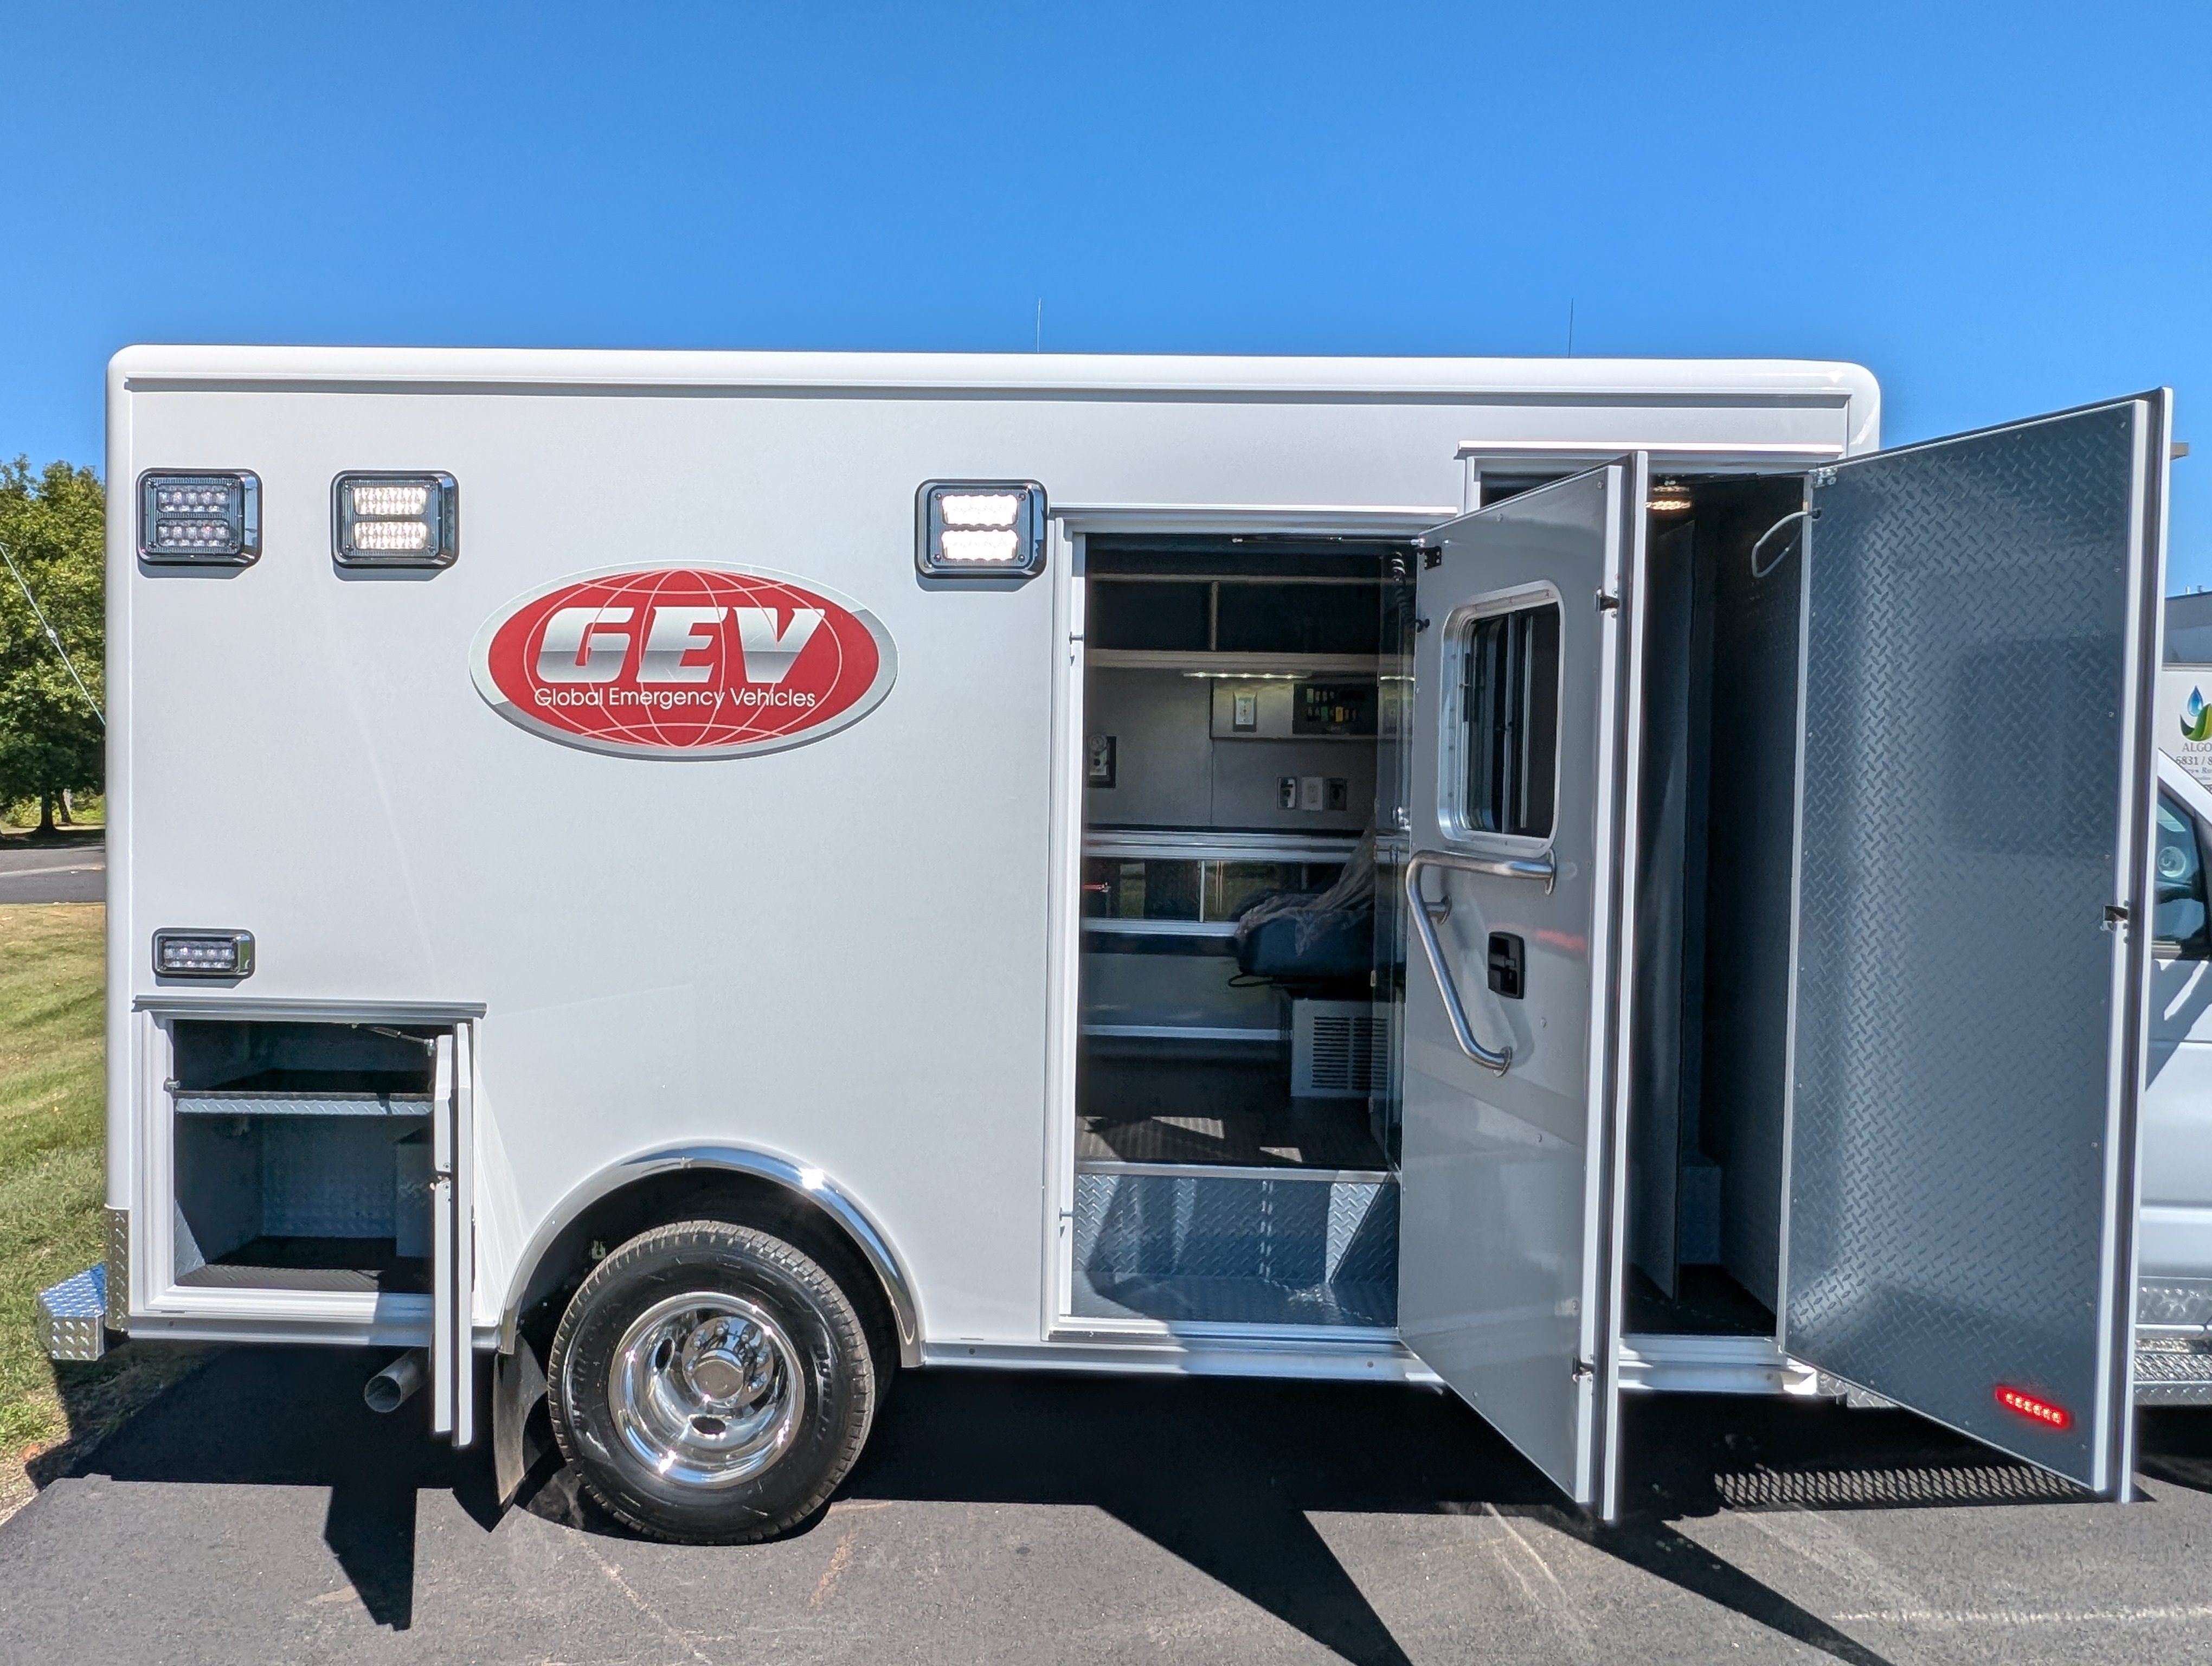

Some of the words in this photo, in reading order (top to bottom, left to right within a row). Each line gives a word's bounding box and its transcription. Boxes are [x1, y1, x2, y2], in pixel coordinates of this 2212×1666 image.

[536, 607, 825, 683] GEV
[535, 688, 603, 706] Global
[609, 688, 725, 710] Emergency
[730, 688, 815, 707] Vehicles
